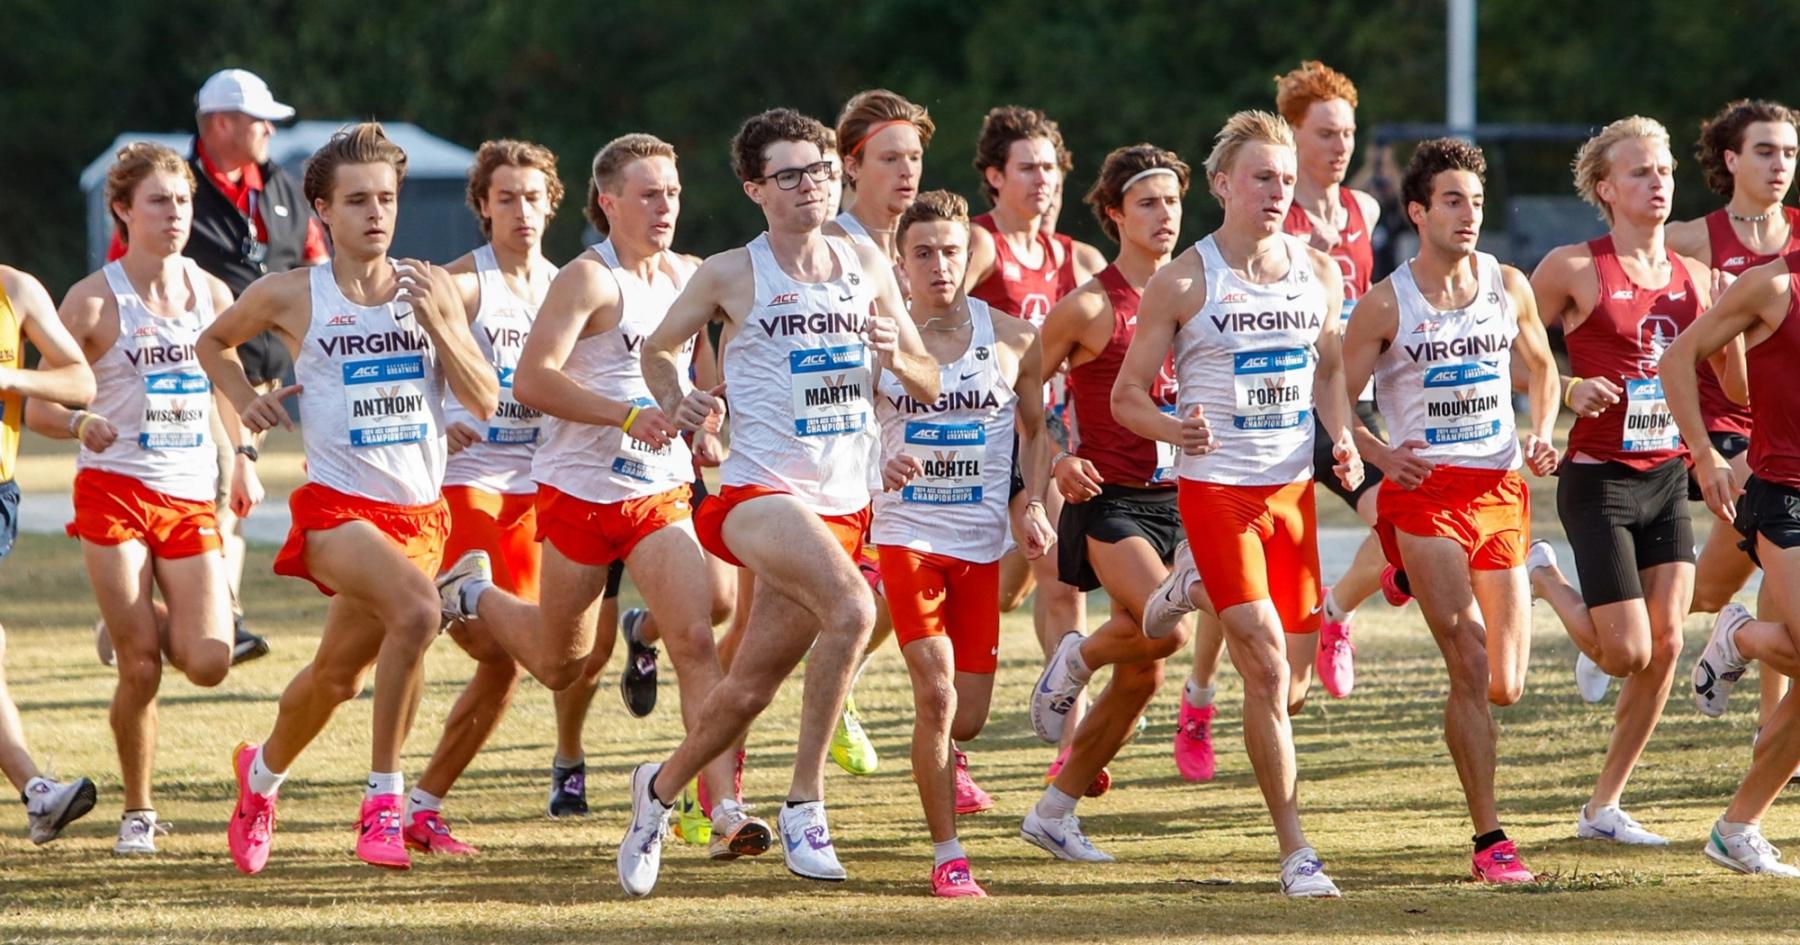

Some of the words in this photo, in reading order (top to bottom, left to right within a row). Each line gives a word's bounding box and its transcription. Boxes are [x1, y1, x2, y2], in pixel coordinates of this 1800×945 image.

[768, 293, 799, 306] ACC
[1218, 293, 1248, 304] ACC
[327, 315, 356, 326] ACC
[1209, 311, 1320, 333] VIRGINIA
[317, 330, 430, 357] VIRGINIA
[1404, 333, 1508, 363] VIRGINIA
[797, 354, 827, 367] ACC
[1240, 357, 1269, 368] ACC
[350, 365, 379, 378] ACC
[1430, 371, 1459, 382] ACC
[805, 384, 860, 406] MARTIN
[1248, 385, 1299, 405] PORTER
[1633, 384, 1657, 395] ACC
[353, 394, 423, 417] ANTHONY
[1428, 395, 1498, 417] MOUNTAIN
[911, 429, 940, 439] ACC
[921, 459, 980, 477] ACHTEL
